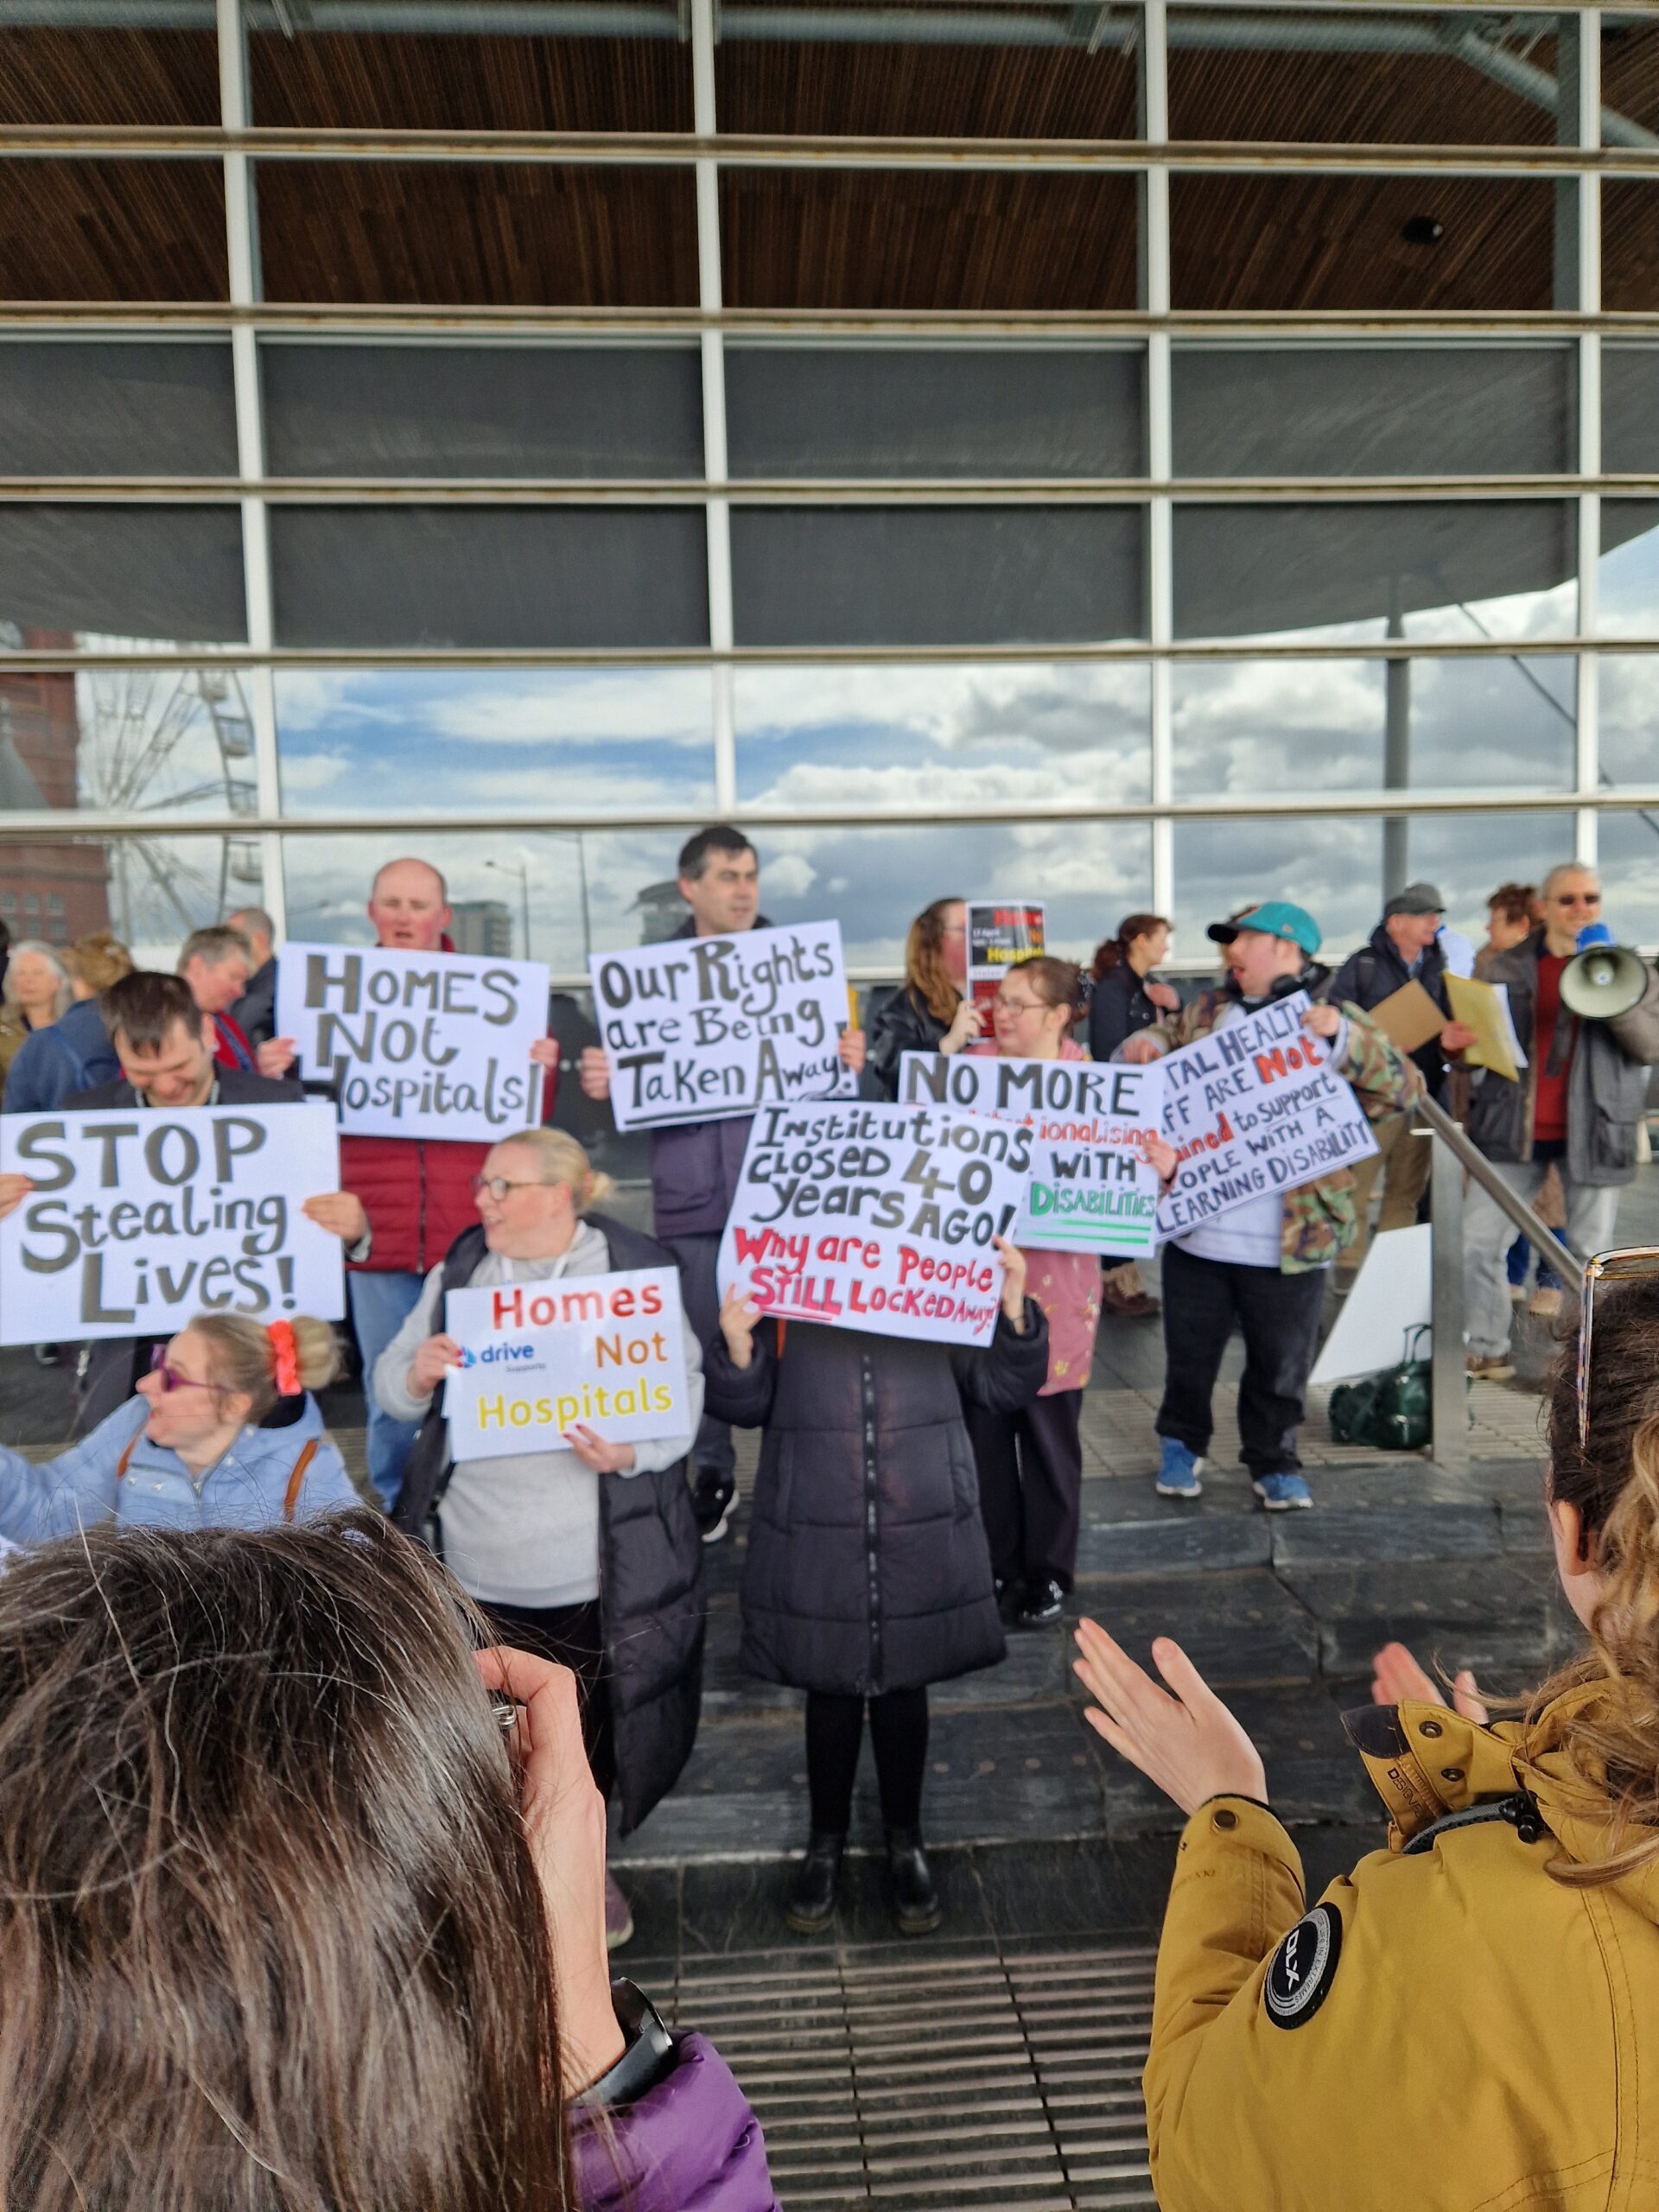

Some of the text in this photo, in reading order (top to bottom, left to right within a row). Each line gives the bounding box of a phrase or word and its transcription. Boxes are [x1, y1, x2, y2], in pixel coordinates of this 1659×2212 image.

[304, 954, 519, 1026] HOMES
[600, 936, 834, 1017] Our Rights
[607, 999, 825, 1051] are Being
[908, 1057, 979, 1106] NO
[996, 1063, 1143, 1116] MORE
[1204, 1069, 1254, 1112] ARE
[1233, 1112, 1257, 1132] to
[1316, 1107, 1335, 1128] A
[16, 1117, 267, 1192] STOP
[900, 1149, 993, 1206] 40
[1156, 1166, 1266, 1234] LEARNING
[21, 1186, 288, 1274] Stealing
[734, 1225, 880, 1275] Why are
[907, 1203, 1017, 1251] AGO!
[80, 1254, 297, 1324] Lives!
[897, 1245, 994, 1293] People
[493, 1285, 663, 1330] Homes
[480, 1343, 534, 1363] drive
[595, 1332, 668, 1369] Not
[478, 1377, 672, 1432] Hospitals
[1285, 1929, 1300, 1992] DLX
